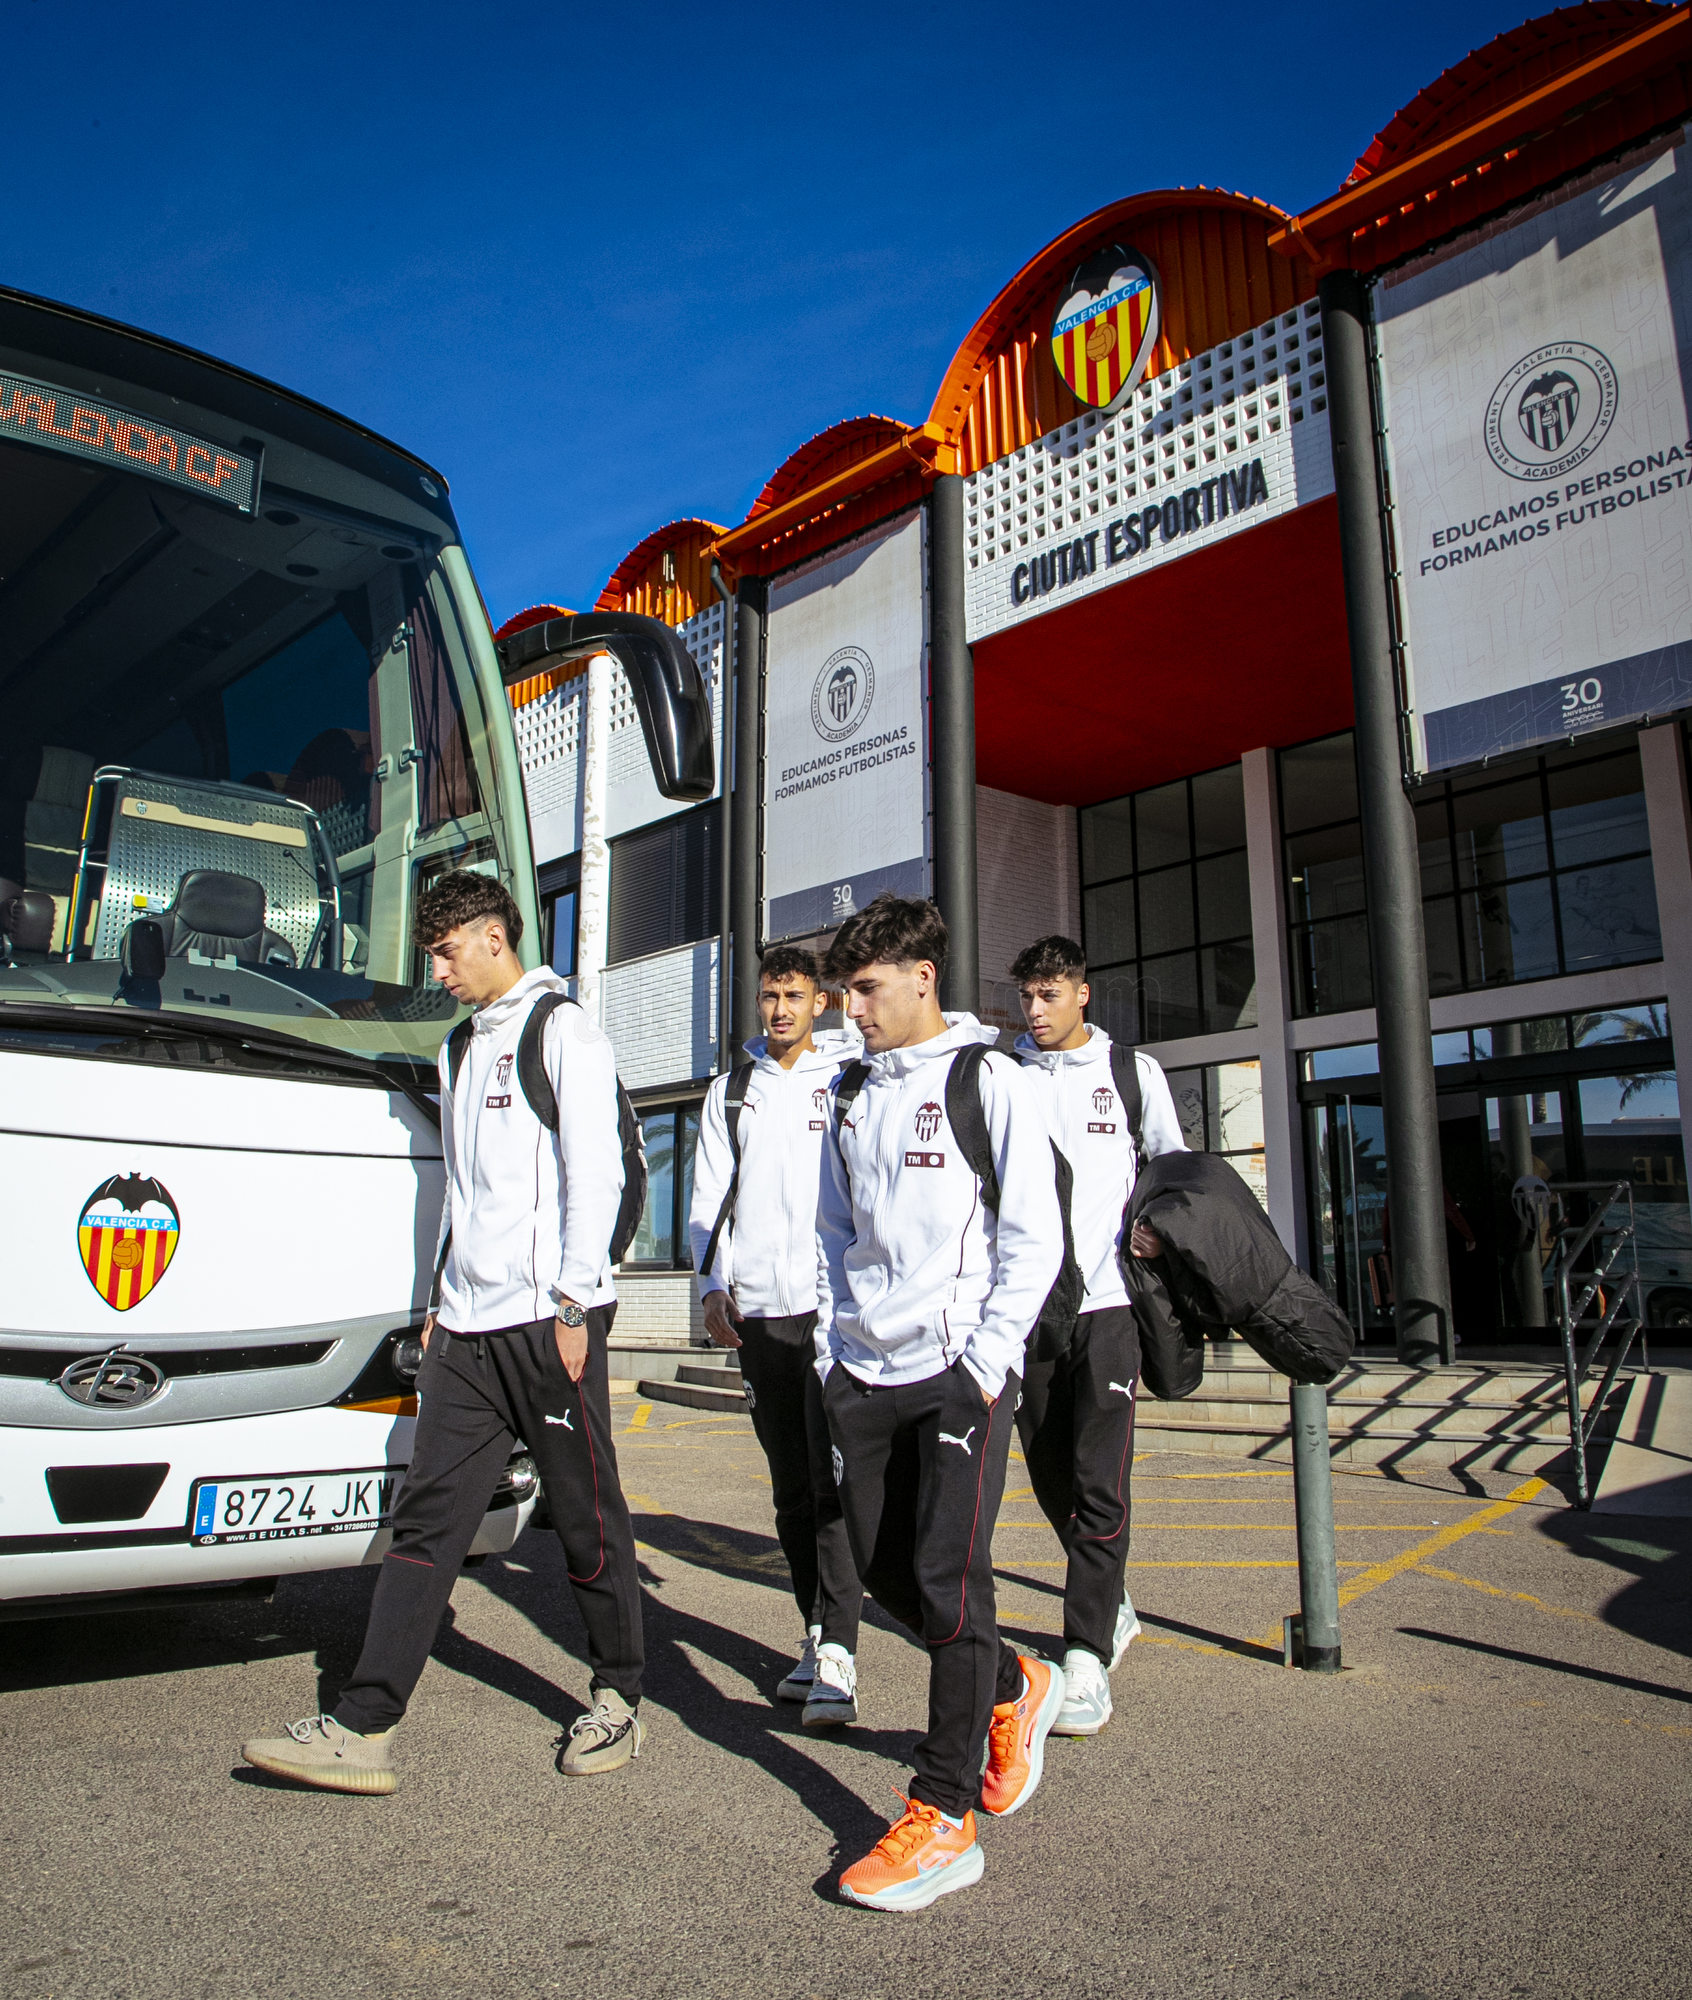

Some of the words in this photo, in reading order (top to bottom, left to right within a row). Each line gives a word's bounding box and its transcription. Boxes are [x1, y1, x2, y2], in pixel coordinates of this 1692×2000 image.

[1057, 294, 1119, 333] VALENCIA
[1122, 279, 1146, 298] C.F.
[1594, 359, 1614, 427] GERMANOR
[1489, 400, 1510, 465] SENTIMENT
[1522, 446, 1590, 478] ACADEMIA
[1012, 529, 1100, 605] CIUTAT
[1108, 457, 1269, 566] ESPORTIVA
[1432, 490, 1560, 549] EDUCAMOS
[1420, 518, 1551, 577] FORMAMOS
[1560, 677, 1602, 711] 30
[1562, 702, 1604, 718] ANIVERSARI
[826, 721, 858, 740] ACADEMIA
[781, 750, 842, 782] EDUCAMOS
[844, 726, 908, 759] PERSONAS
[774, 769, 836, 801] FORMAMOS
[838, 741, 916, 779] FUTBOLISTAS
[833, 884, 852, 905] 30
[488, 1098, 500, 1107] TM
[1089, 1124, 1100, 1132] TM
[906, 1154, 921, 1165] TM
[86, 1216, 148, 1229] VALENCIA
[151, 1219, 173, 1230] C.F.
[223, 1484, 316, 1527] 8724
[331, 1478, 395, 1518] JKW
[201, 1515, 209, 1526] E
[330, 1524, 343, 1532] +34
